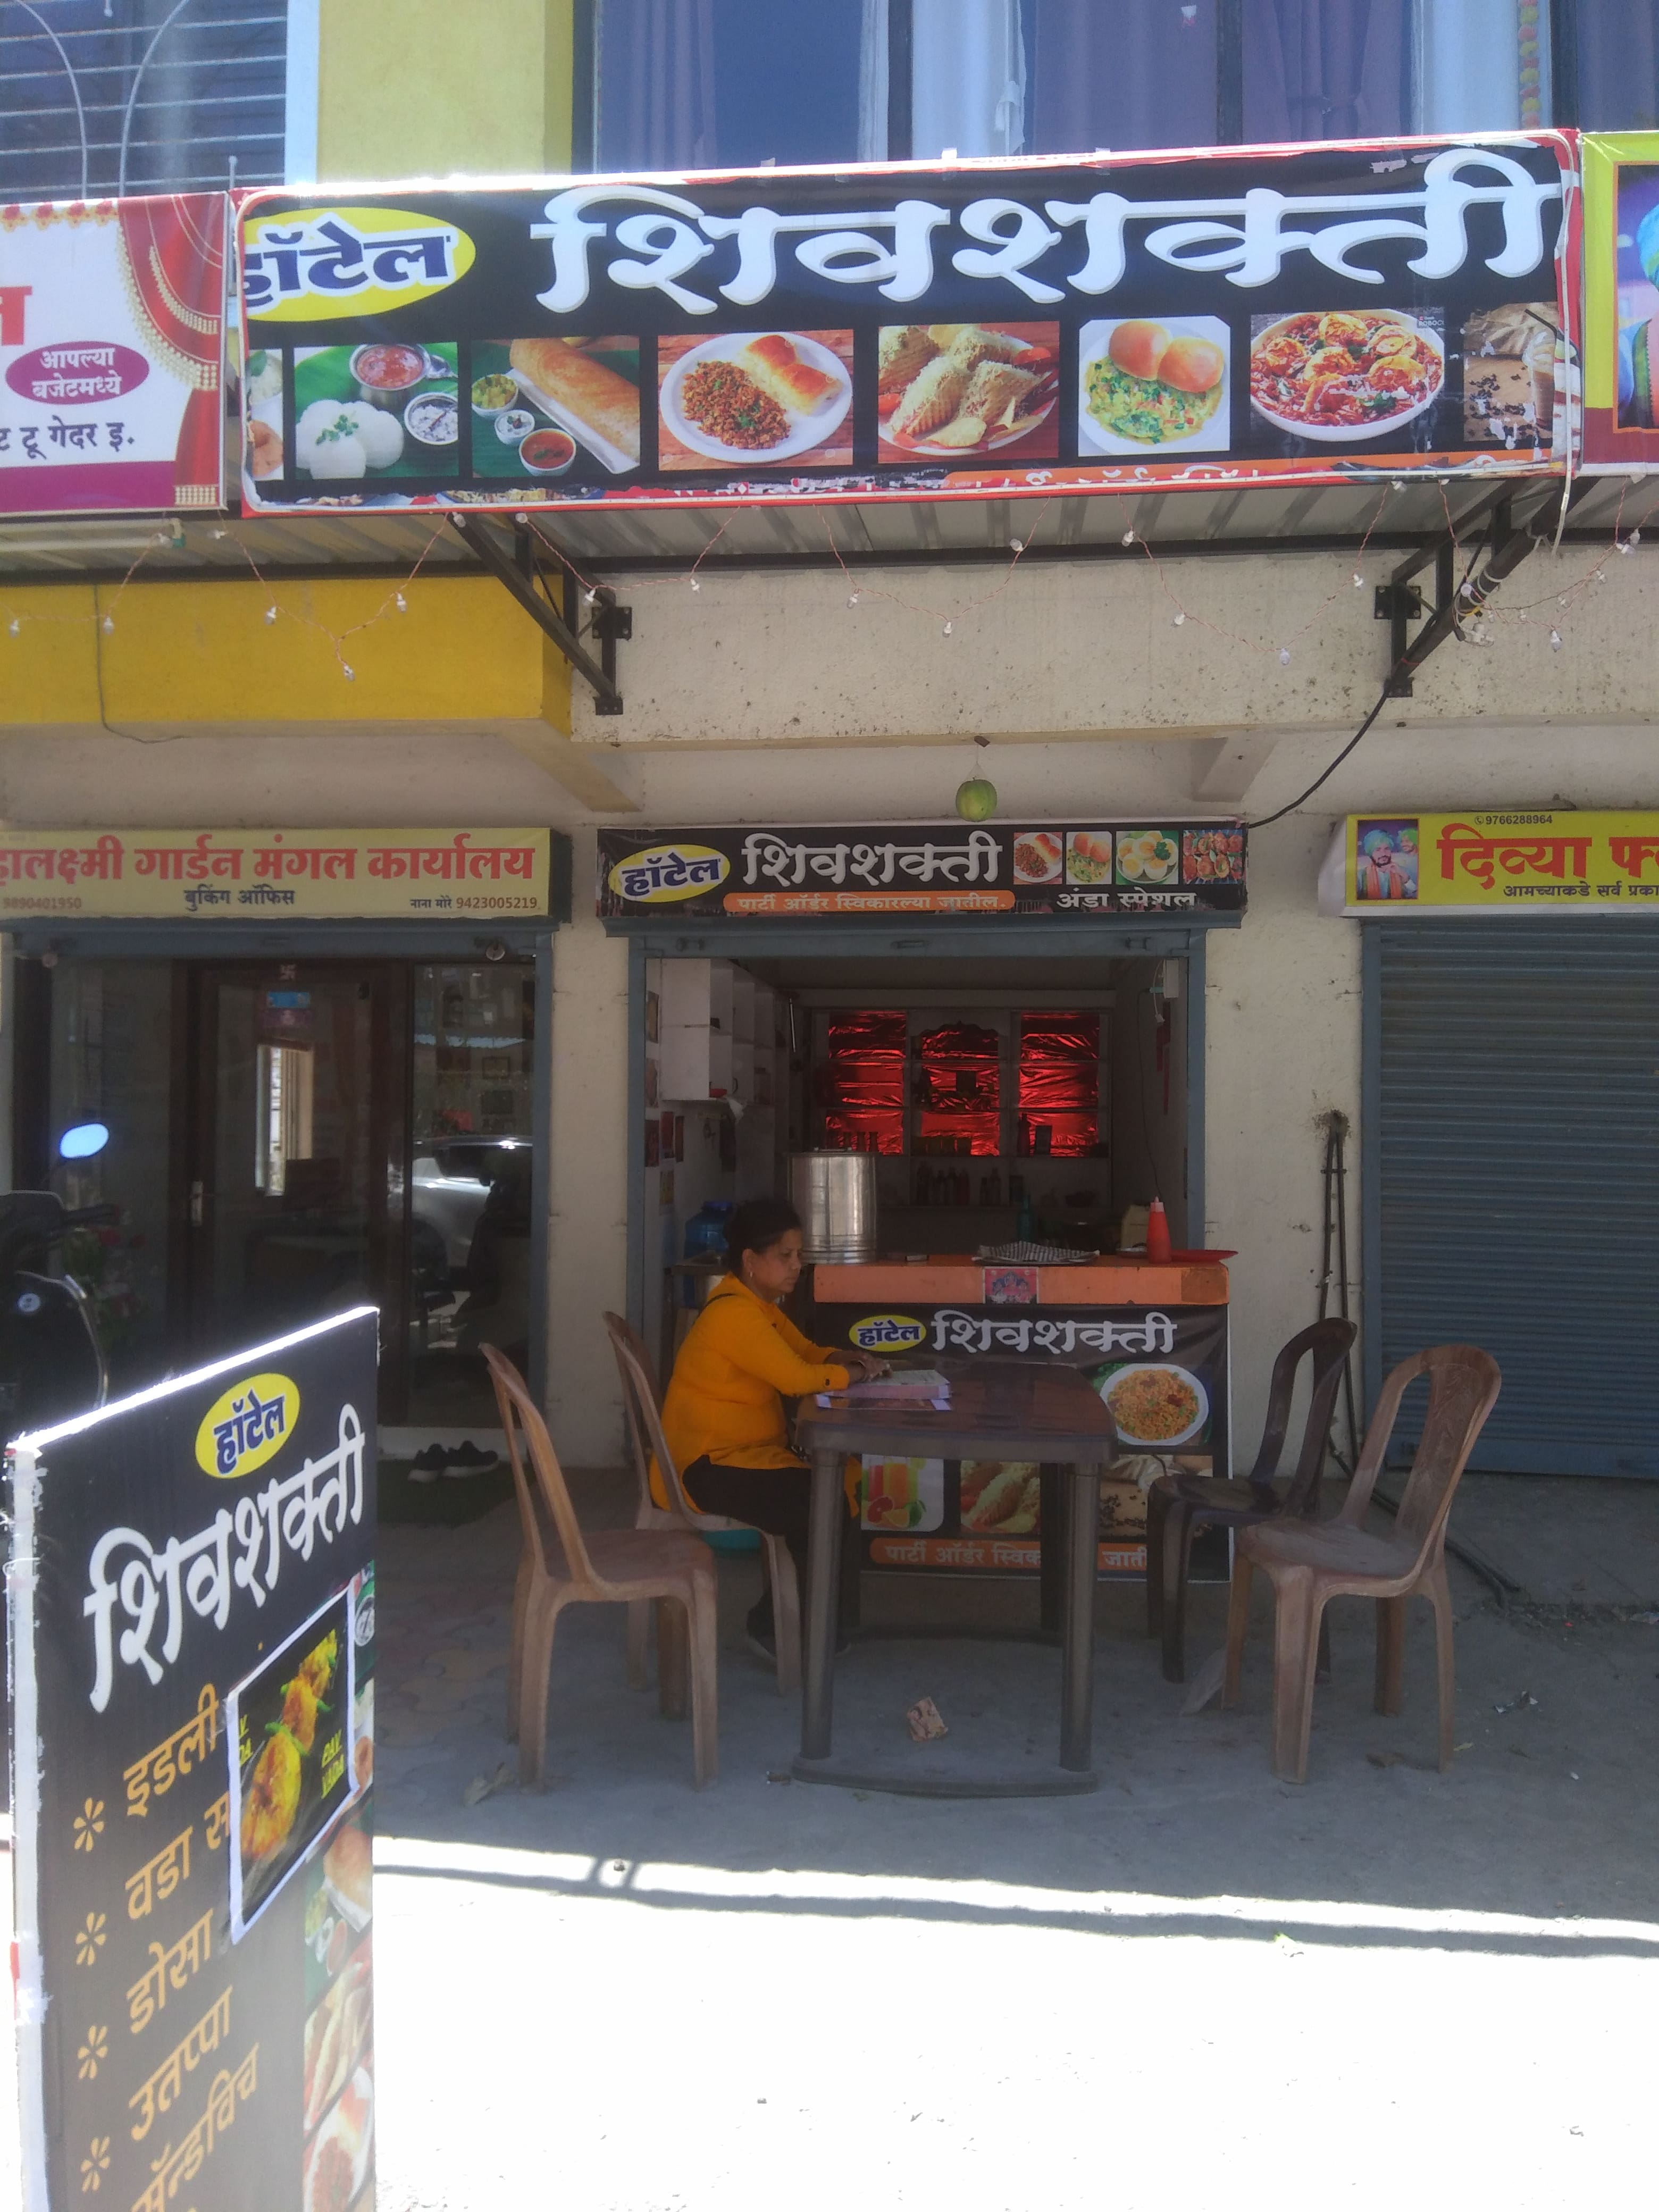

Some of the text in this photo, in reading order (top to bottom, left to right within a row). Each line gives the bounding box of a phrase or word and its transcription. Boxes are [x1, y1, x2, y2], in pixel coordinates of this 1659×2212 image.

[530, 148, 1562, 315] शिवशक्ती
[39, 347, 115, 370] आपल्या
[32, 370, 122, 399] बजेटमध्ये
[20, 427, 47, 459] टू
[48, 415, 98, 450] गेदर
[1485, 815, 1553, 825] 9766288964
[134, 833, 244, 880] गार्डन
[253, 833, 358, 880] मंगल
[367, 833, 535, 879] कार्यालय
[621, 831, 1003, 896] हॉटेल शिवशक्ती
[1436, 823, 1659, 890] दिव्या फ
[183, 883, 296, 911] बुकिंग ऑफिस
[410, 895, 538, 909] नाना मोरे 9423005219
[737, 892, 776, 910] पार्टी
[783, 892, 828, 910] ऑर्डर
[835, 892, 931, 910] स्विकारल्या
[1057, 886, 1197, 908] अंडा स्पेशल
[1503, 881, 1591, 897] आमच्याकडे
[1596, 881, 1622, 898] सर्व
[858, 1310, 1177, 1354] हॉटेल शिवशक्ती
[213, 1389, 286, 1475] हॉटेल
[83, 1403, 365, 1714] शिवशक्ती
[884, 1537, 927, 1562] पार्टी
[935, 1542, 985, 1565] ऑर्डर
[123, 1682, 220, 1818] इडली
[125, 1825, 194, 1921] वडा
[127, 1907, 213, 2034] डोसा
[129, 1984, 233, 2141] उतप्पा
